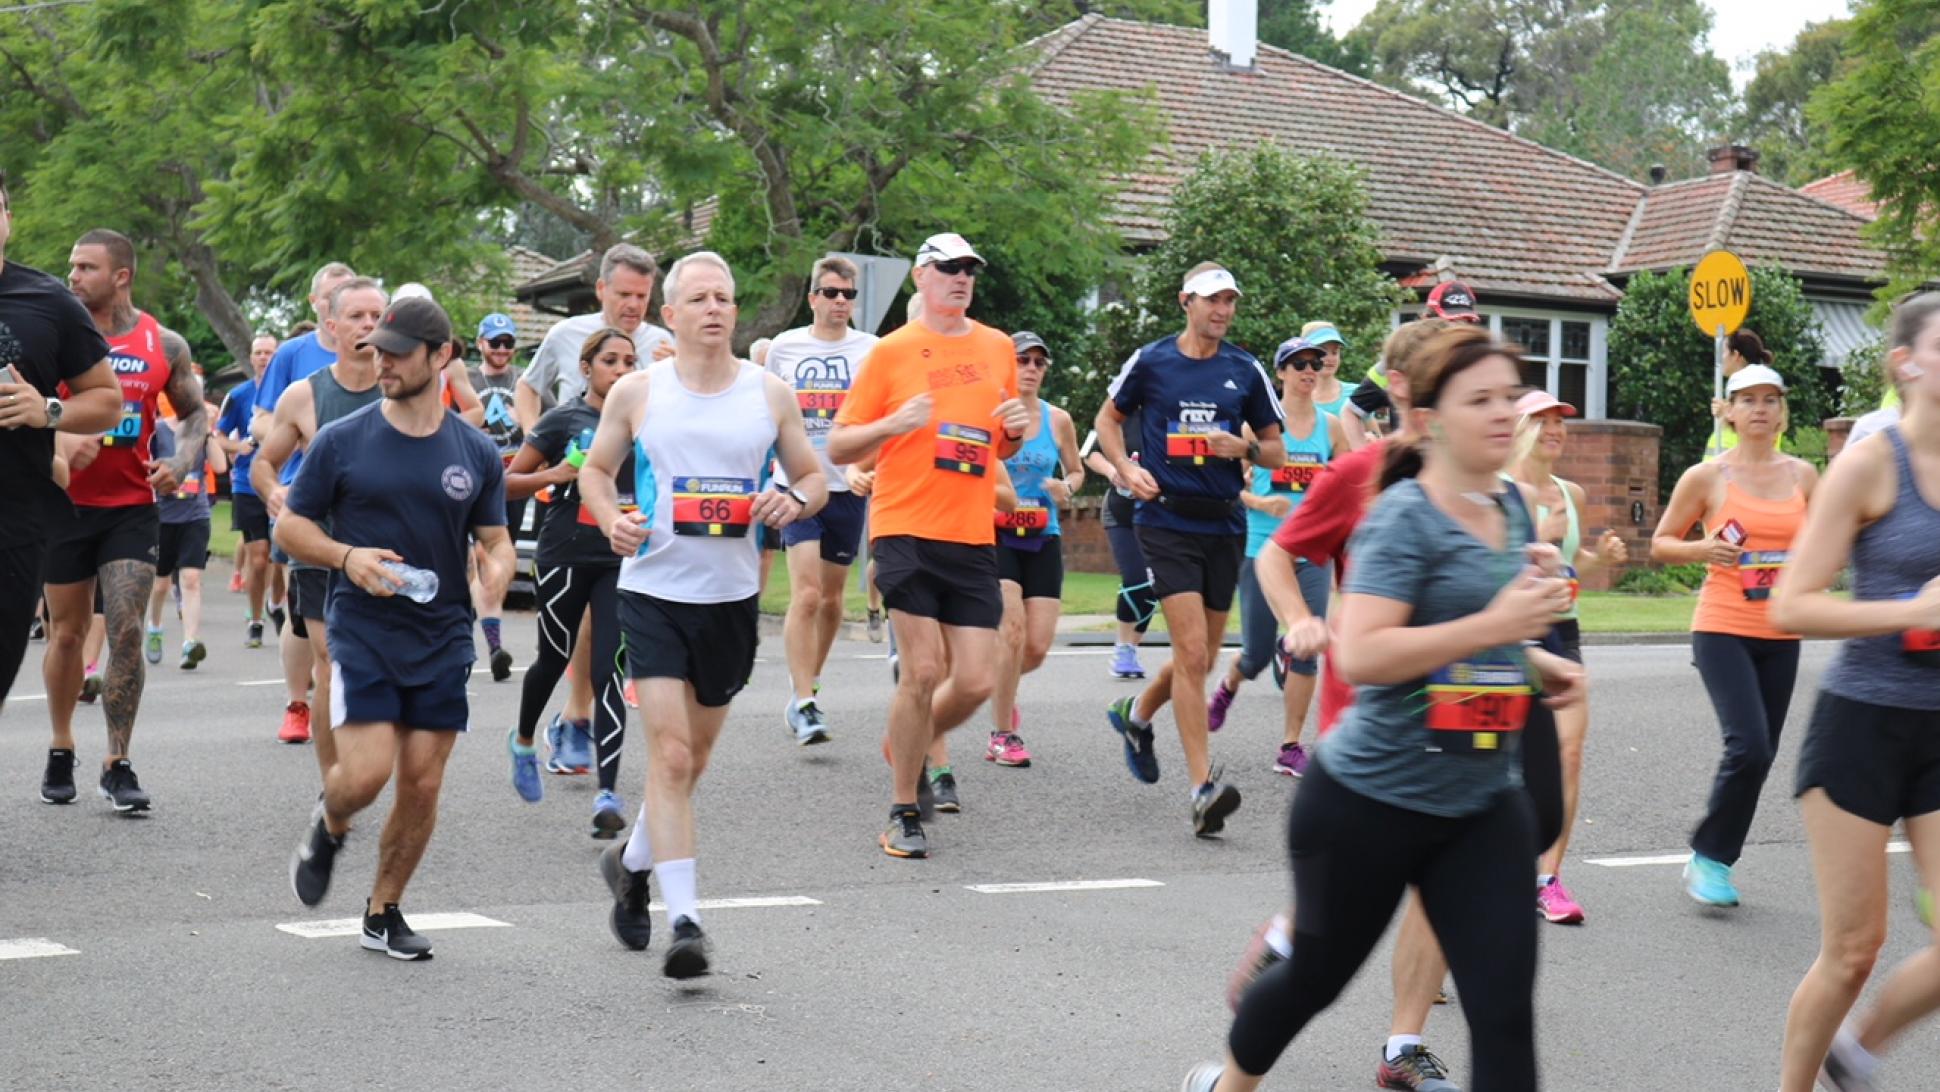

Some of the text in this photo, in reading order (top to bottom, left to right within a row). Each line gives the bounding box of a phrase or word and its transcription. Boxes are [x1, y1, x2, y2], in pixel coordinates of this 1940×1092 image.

[1693, 277, 1745, 310] SLOW
[805, 393, 836, 408] 311
[955, 442, 978, 462] 95
[1188, 438, 1209, 456] 11
[1283, 466, 1313, 482] 595
[701, 483, 744, 493] FUNRUN
[700, 498, 731, 521] 66
[1005, 511, 1036, 527] 286
